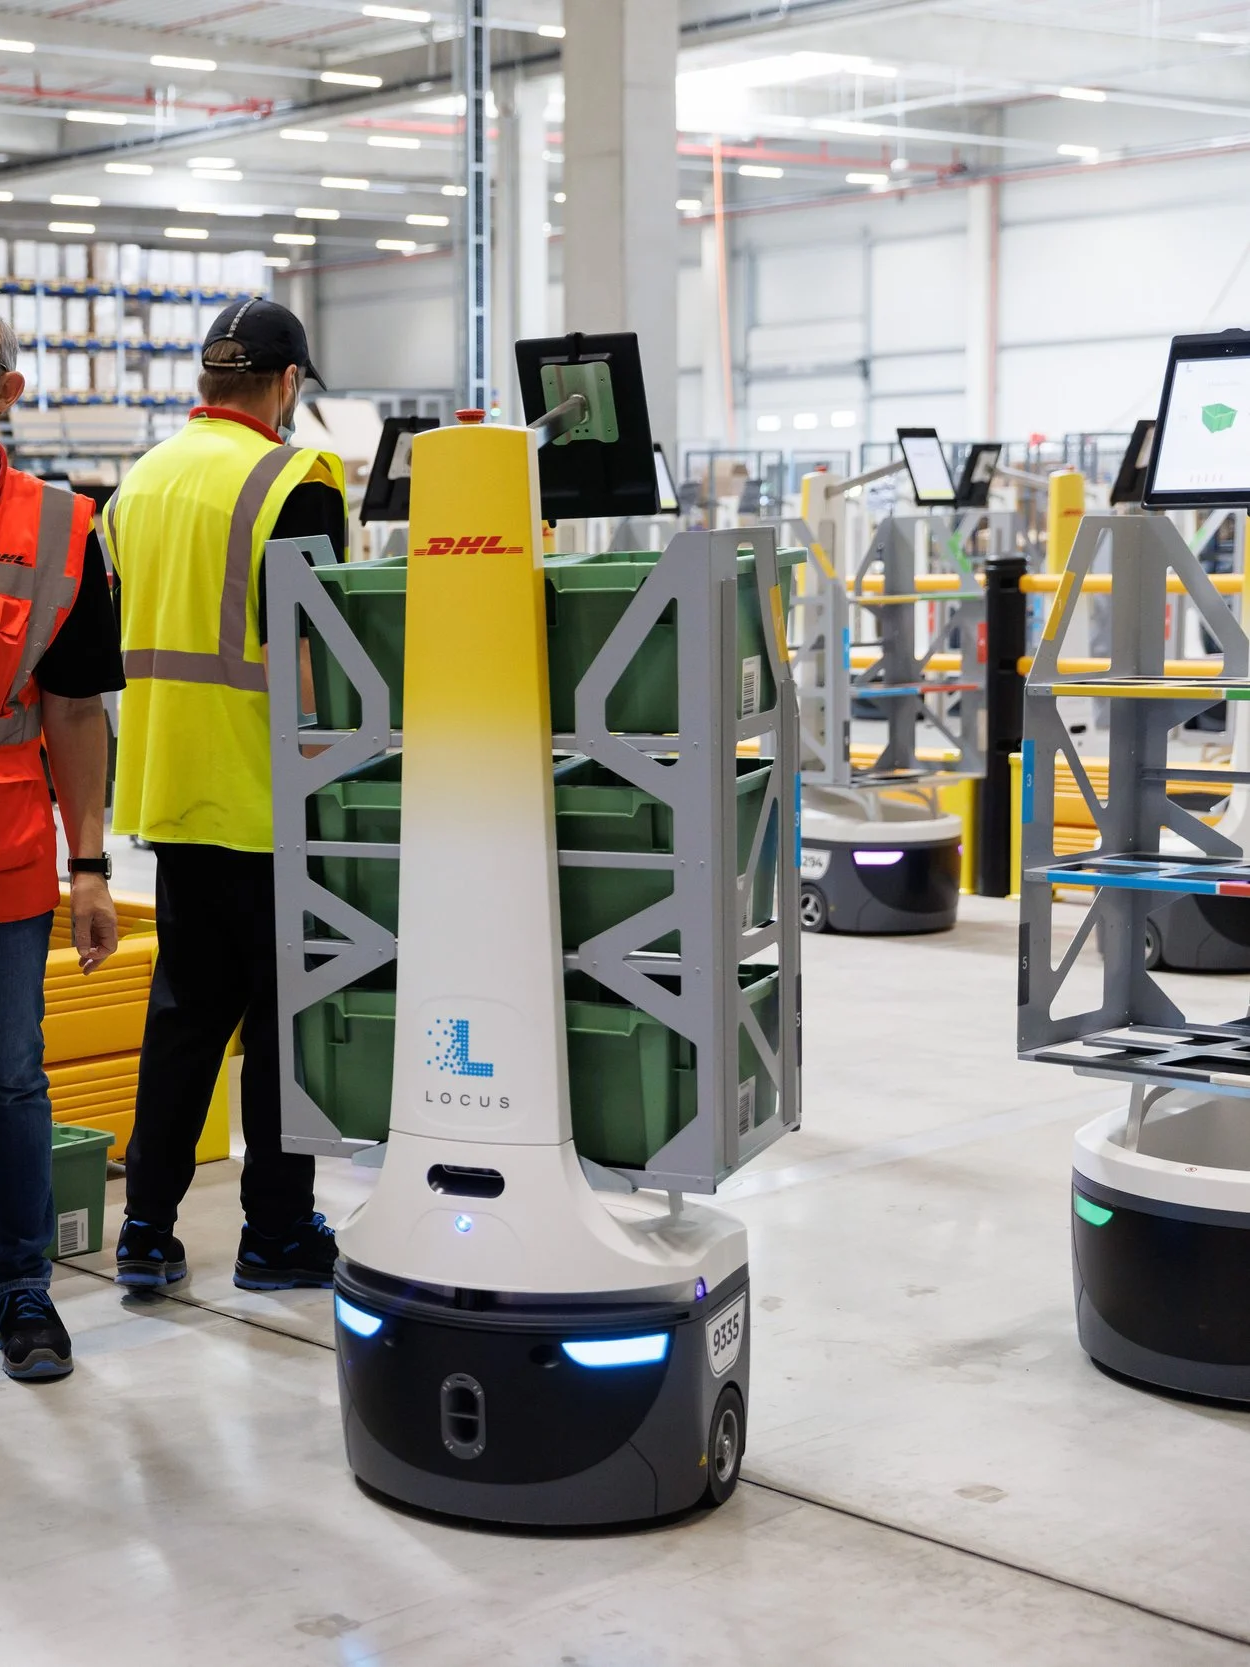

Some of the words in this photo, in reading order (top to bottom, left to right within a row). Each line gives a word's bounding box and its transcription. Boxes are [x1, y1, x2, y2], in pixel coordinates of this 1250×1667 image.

[427, 536, 508, 556] DHL
[1026, 773, 1032, 787] 3
[1022, 955, 1028, 970] 5
[796, 1011, 801, 1028] 5
[425, 1090, 511, 1109] LOCUS
[713, 1311, 739, 1357] 9335
